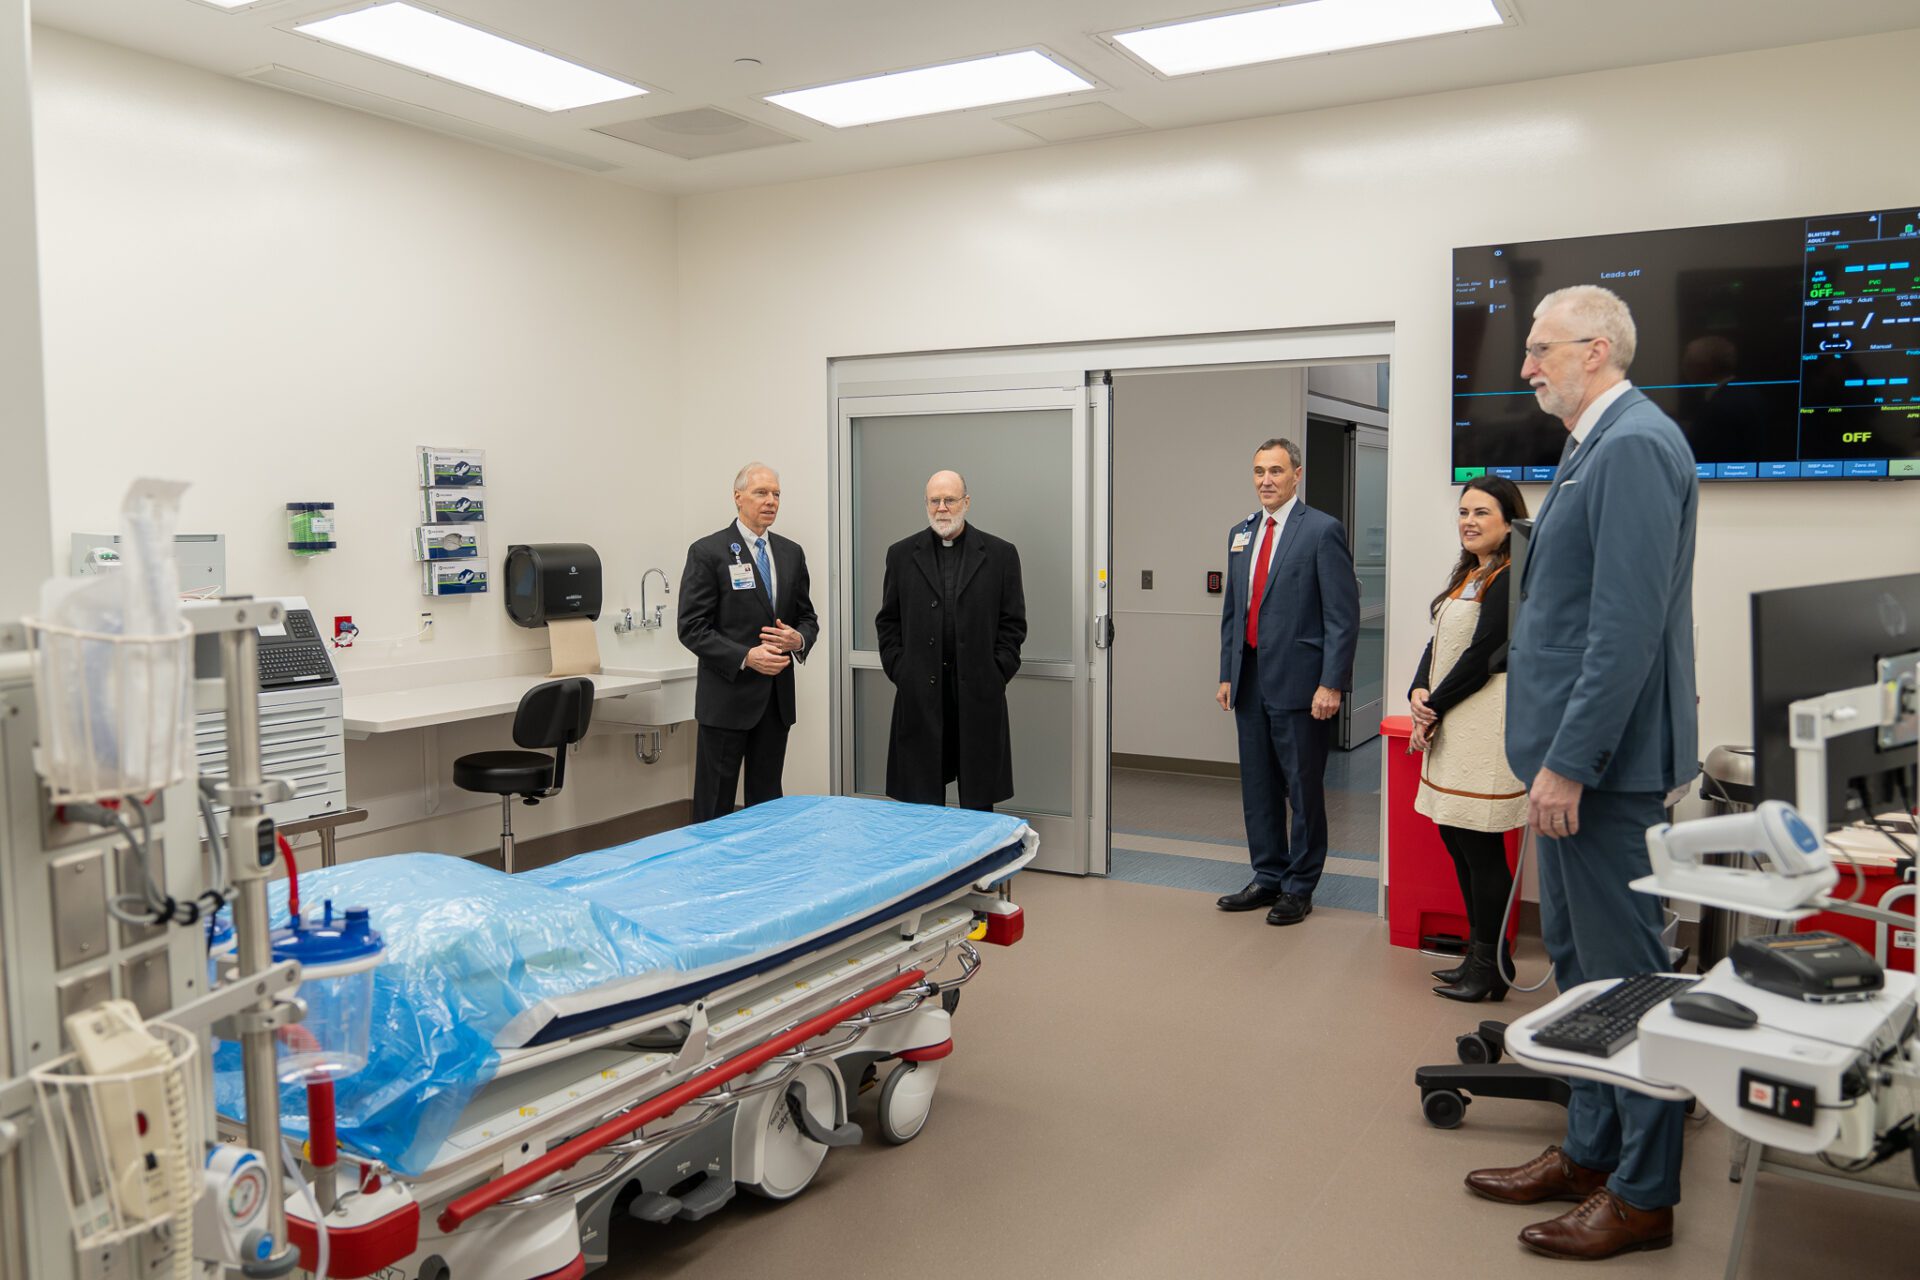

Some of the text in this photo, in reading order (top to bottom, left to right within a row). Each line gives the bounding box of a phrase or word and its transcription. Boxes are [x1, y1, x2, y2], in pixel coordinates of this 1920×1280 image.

[1600, 269, 1641, 279] Leads off
[1809, 288, 1833, 298] OFF
[1842, 432, 1872, 443] OFF
